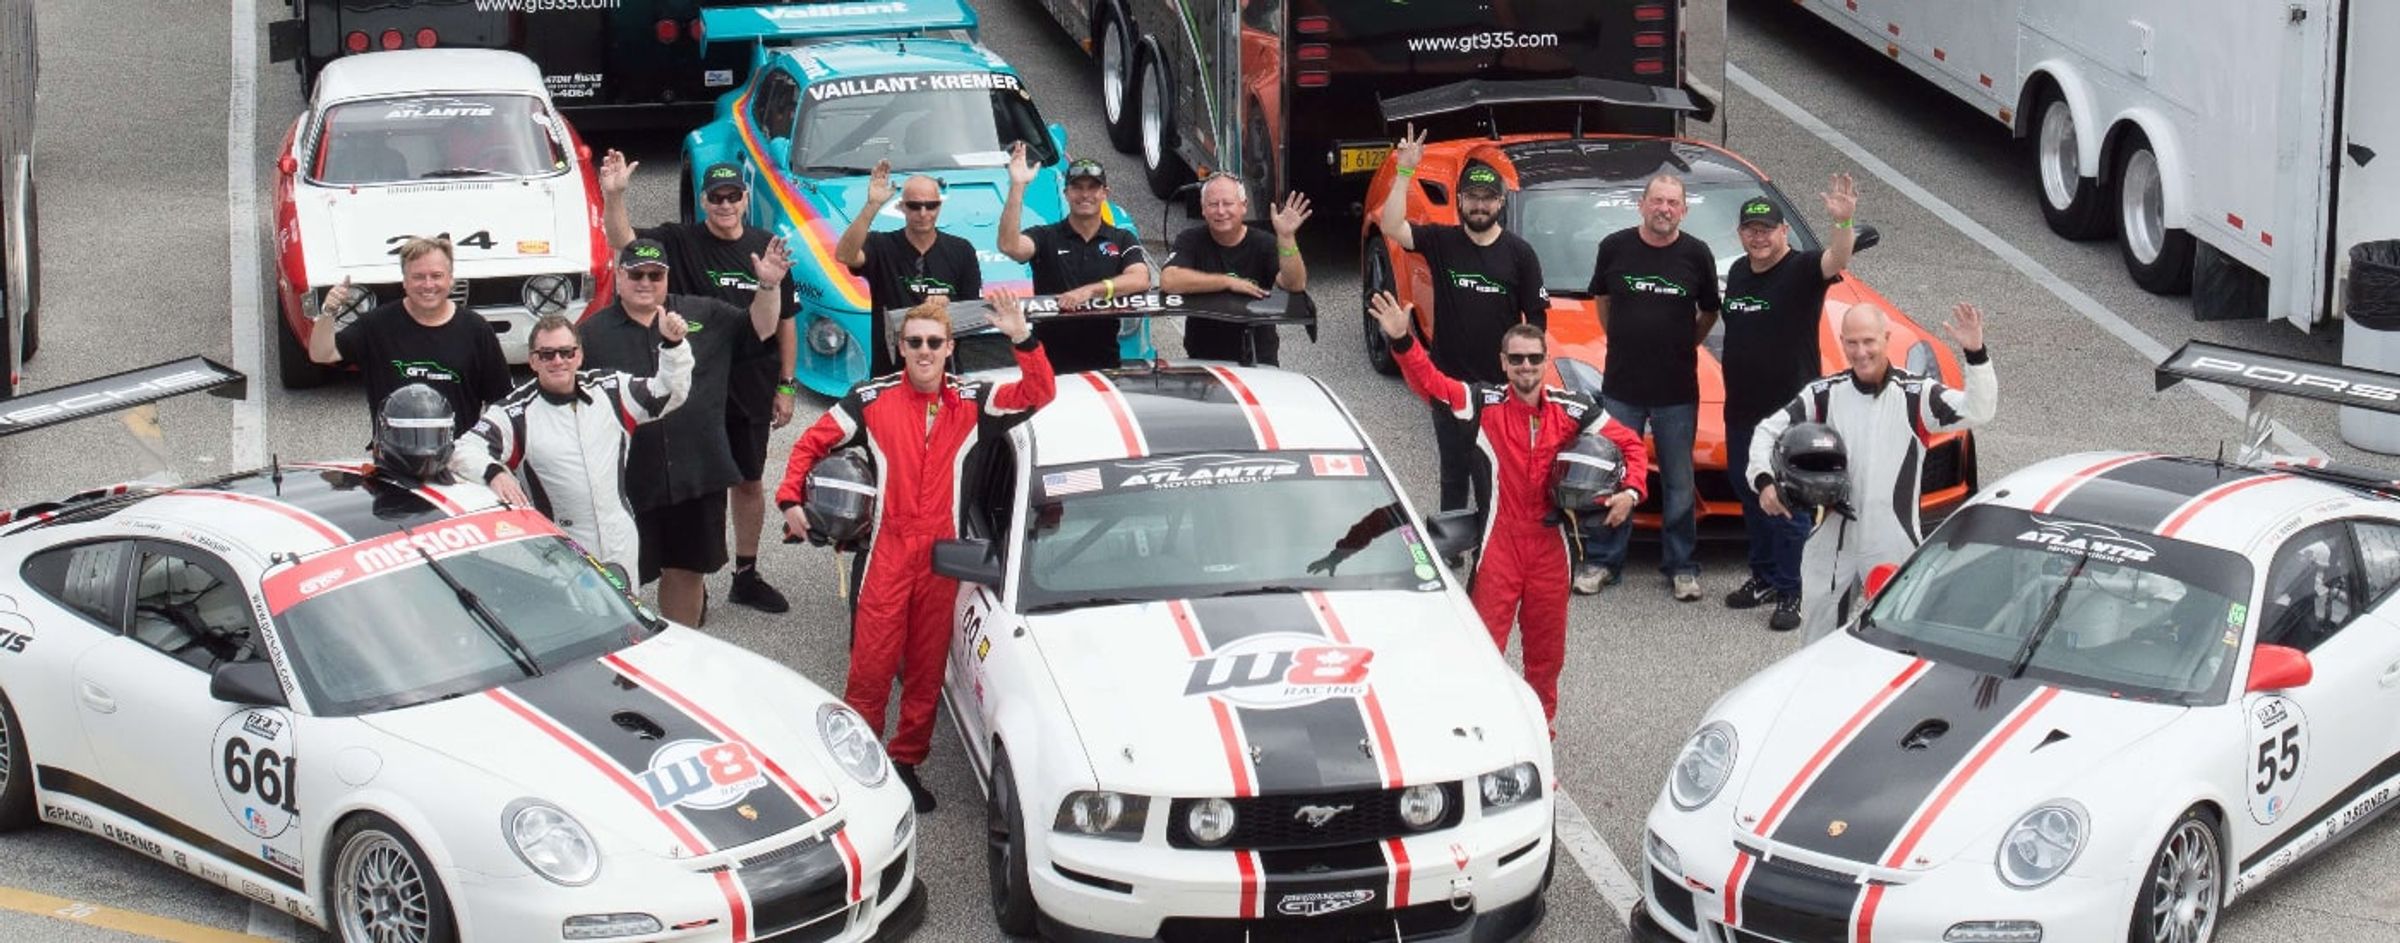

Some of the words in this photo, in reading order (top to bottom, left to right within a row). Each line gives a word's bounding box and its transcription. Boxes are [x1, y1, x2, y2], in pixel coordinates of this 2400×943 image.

[754, 2, 908, 20] Vaillant
[1407, 31, 1558, 52] www.gt935.com
[809, 77, 918, 101] VAILLANT
[931, 73, 1020, 91] KREMER
[384, 107, 495, 119] ATLANTIS
[1014, 294, 1161, 313] ARHOUSE
[1165, 294, 1184, 307] 8
[0, 369, 208, 424] SCHE
[1120, 464, 1301, 487] ATLANTIS
[1154, 480, 1214, 490] MOTOR
[1217, 475, 1272, 486] GROUP
[353, 522, 489, 574] MISSION
[2016, 531, 2157, 562] ATLANTIS
[1284, 685, 1363, 696] RACING
[2256, 723, 2300, 795] 55
[224, 736, 299, 816] 661
